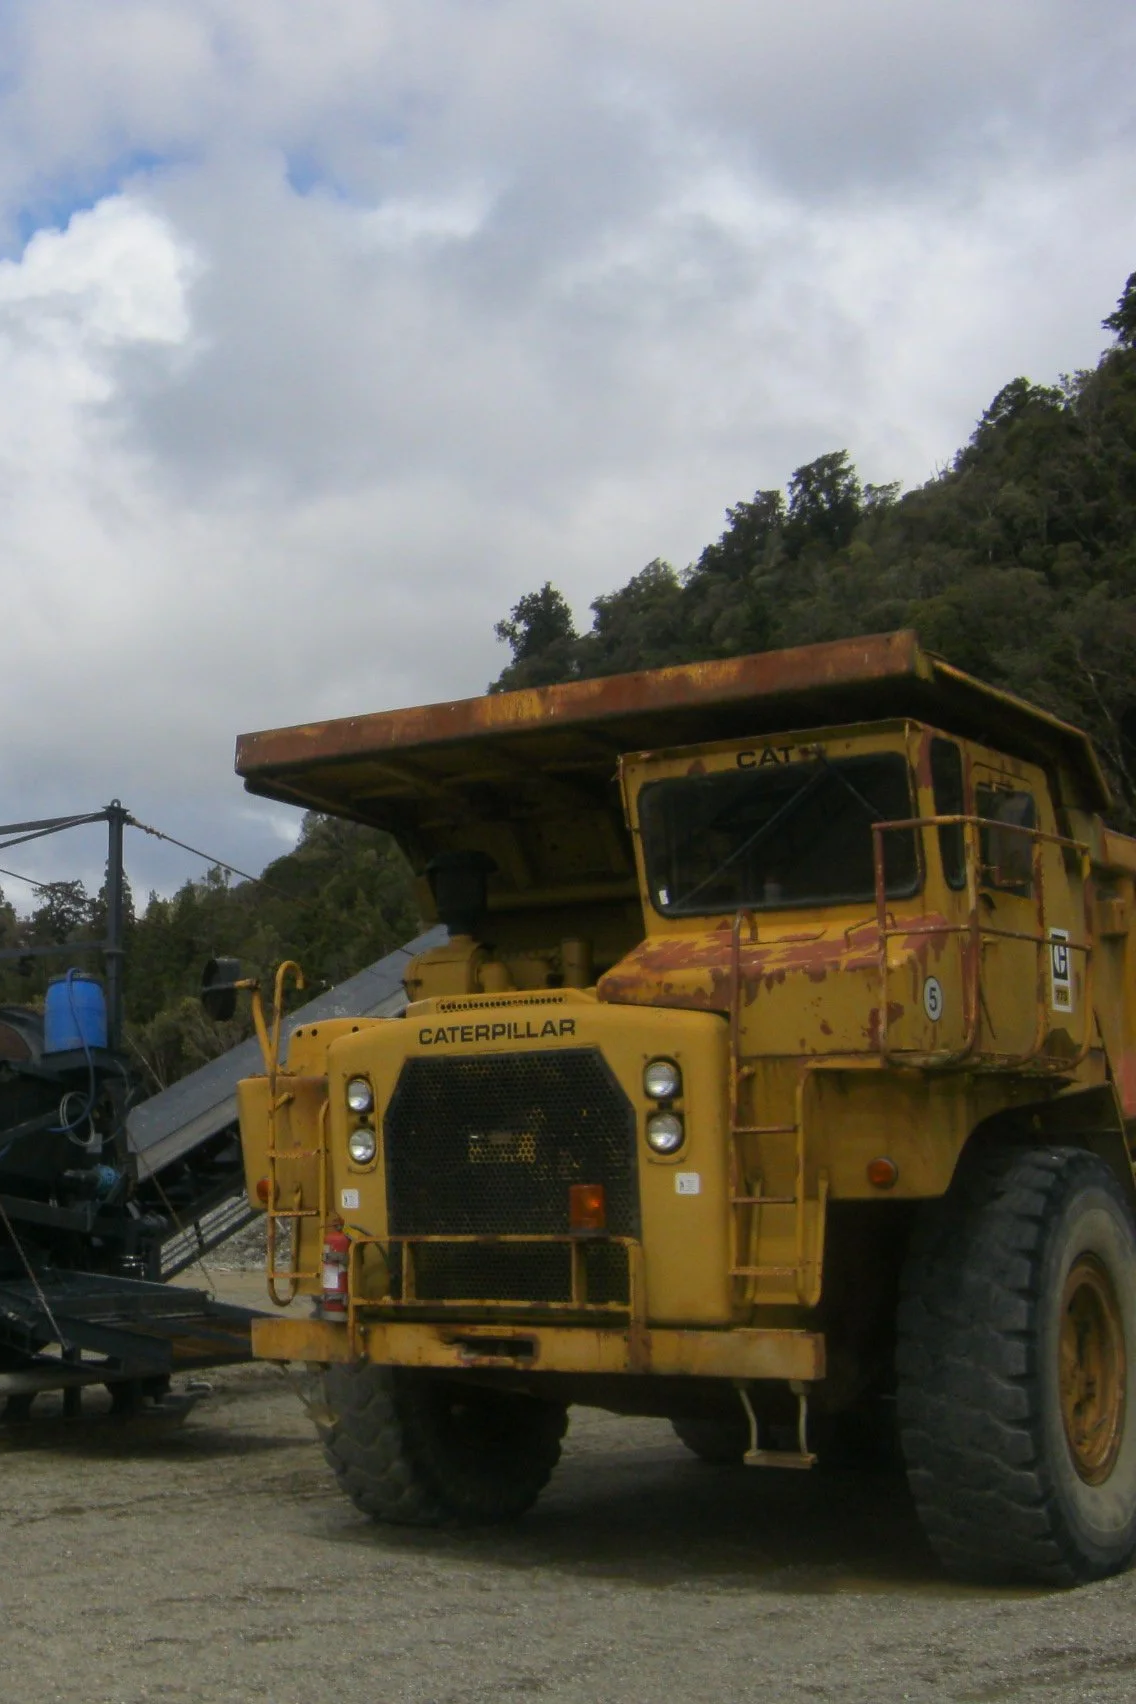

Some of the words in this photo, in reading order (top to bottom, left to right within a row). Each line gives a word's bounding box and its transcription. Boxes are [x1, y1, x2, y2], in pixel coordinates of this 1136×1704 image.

[736, 745, 795, 769] CAT
[928, 986, 937, 1012] 5
[419, 1018, 576, 1045] CATERPILLAR
